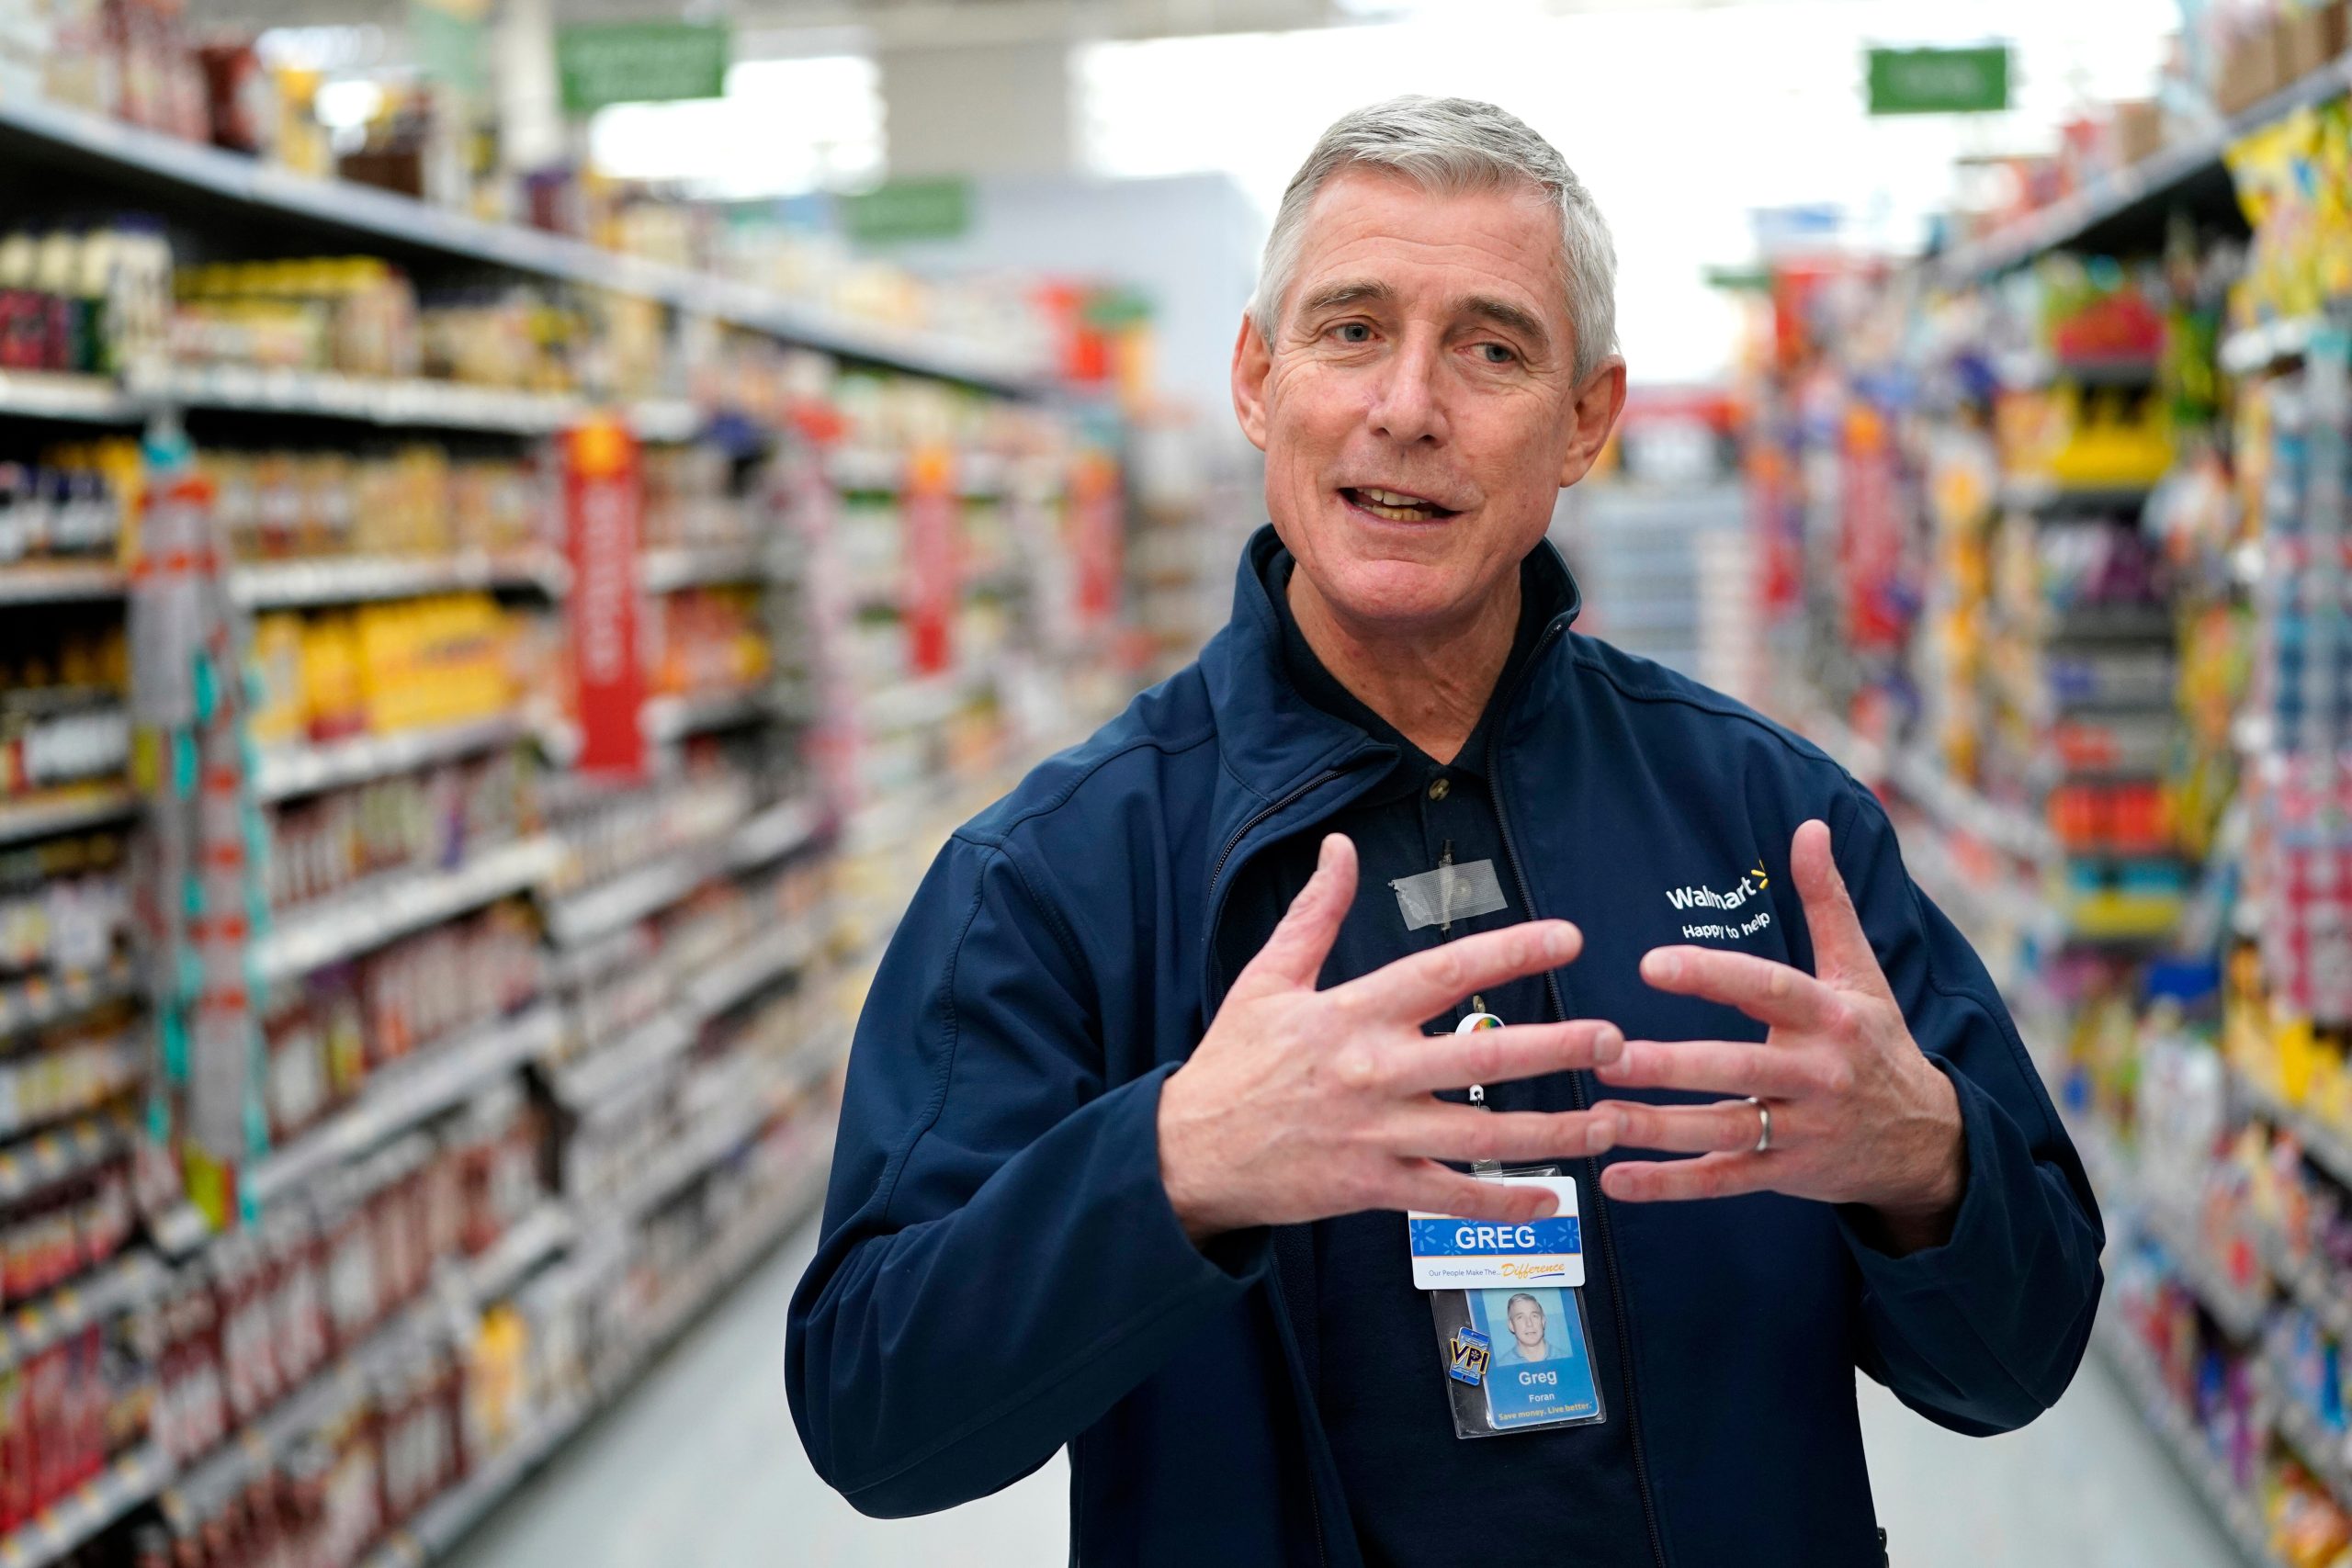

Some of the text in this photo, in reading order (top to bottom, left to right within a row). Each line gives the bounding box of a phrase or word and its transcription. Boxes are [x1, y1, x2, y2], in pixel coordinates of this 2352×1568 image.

[1666, 876, 1757, 910] Walmart
[1682, 912, 1770, 940] Happy to help
[1455, 1225, 1535, 1249] GREG
[1501, 1262, 1565, 1280] Difference
[1450, 1337, 1490, 1375] VPI
[1519, 1371, 1557, 1386] Greg
[1529, 1393, 1555, 1404] Foran
[1498, 1412, 1518, 1421] Save
[1518, 1409, 1547, 1417] money.
[1547, 1406, 1564, 1415] Live
